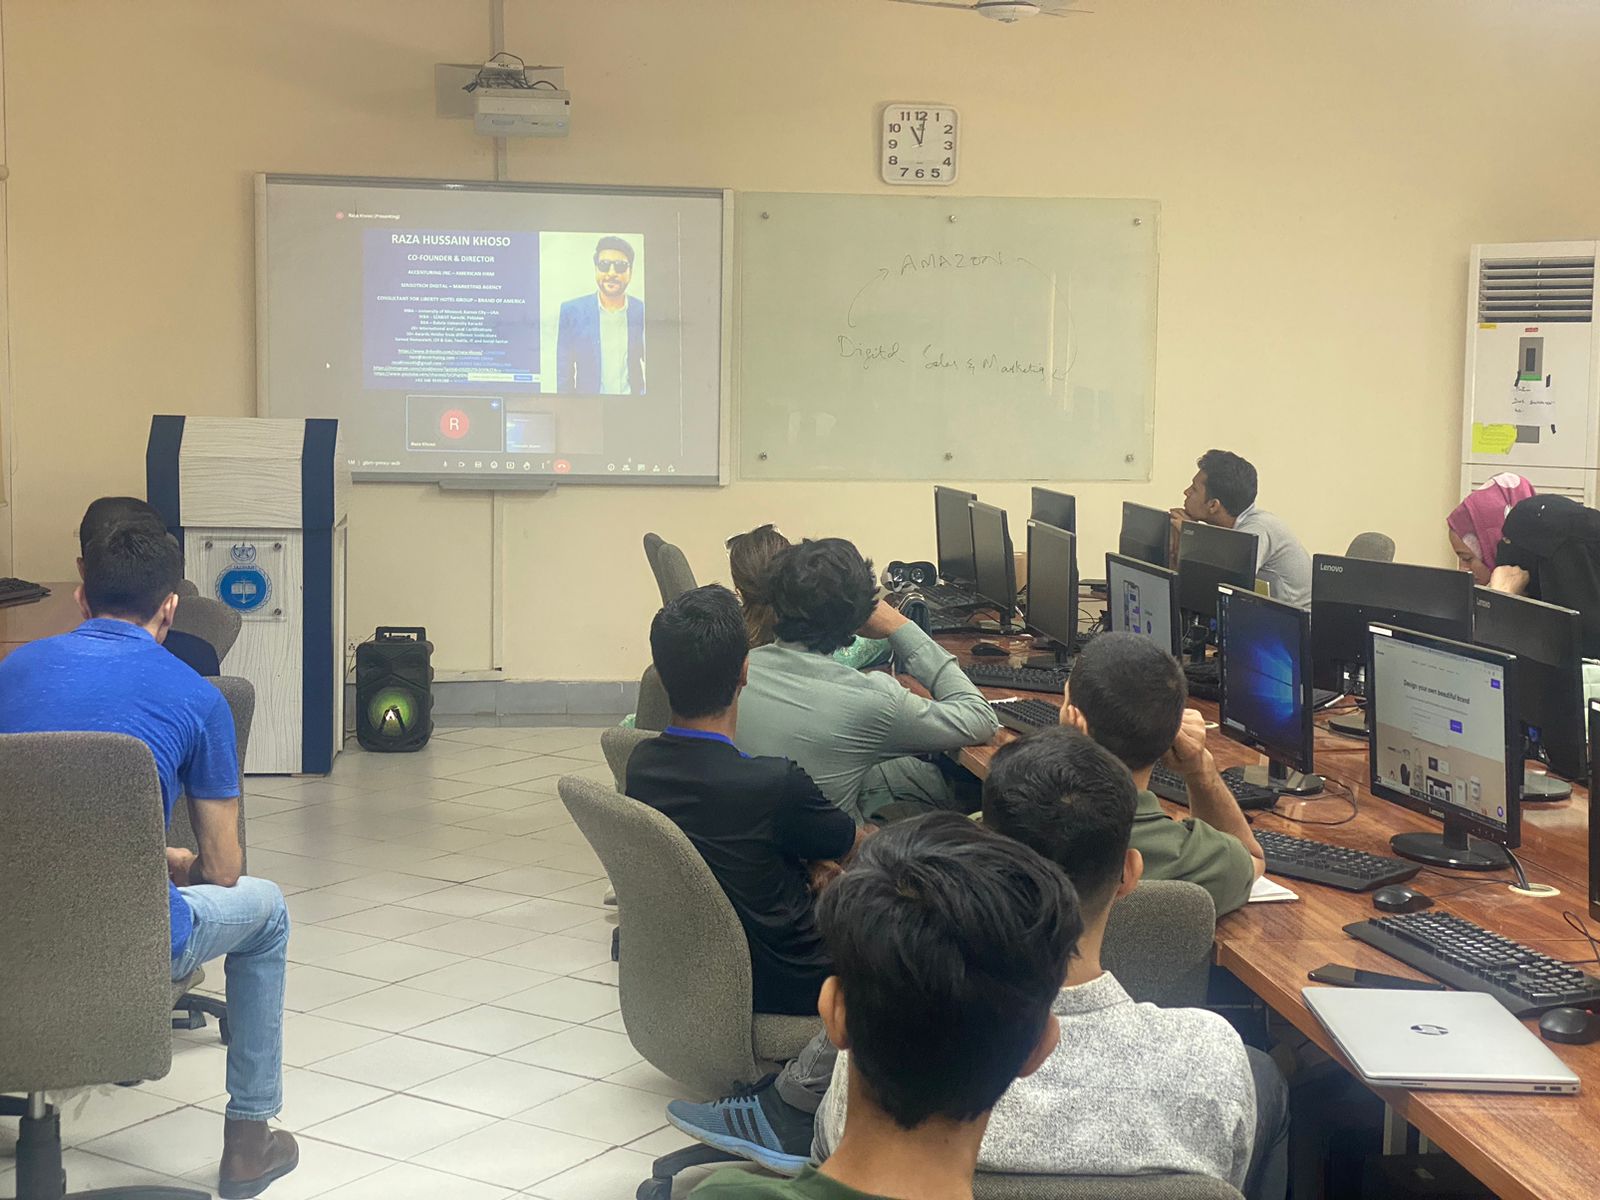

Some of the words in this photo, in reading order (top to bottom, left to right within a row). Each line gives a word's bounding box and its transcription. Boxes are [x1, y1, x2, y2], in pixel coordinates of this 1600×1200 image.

[900, 111, 911, 121] 11
[915, 111, 928, 121] 12
[889, 123, 901, 133] 10
[944, 124, 953, 134] 2
[888, 139, 898, 149] 9
[944, 141, 953, 150] 3
[888, 155, 898, 165] 8
[942, 157, 952, 167] 4
[900, 167, 909, 177] 7
[915, 168, 925, 178] 6
[931, 168, 940, 178] 5
[391, 234, 420, 245] RAZA
[422, 235, 470, 246] HUSSAIN
[472, 236, 511, 247] KHOSO
[407, 254, 452, 262] CO-FOUNDER
[461, 255, 495, 263] DIRECTOR
[900, 251, 1003, 276] AMAZON
[449, 417, 459, 430] R
[1320, 562, 1344, 573] Lenovo
